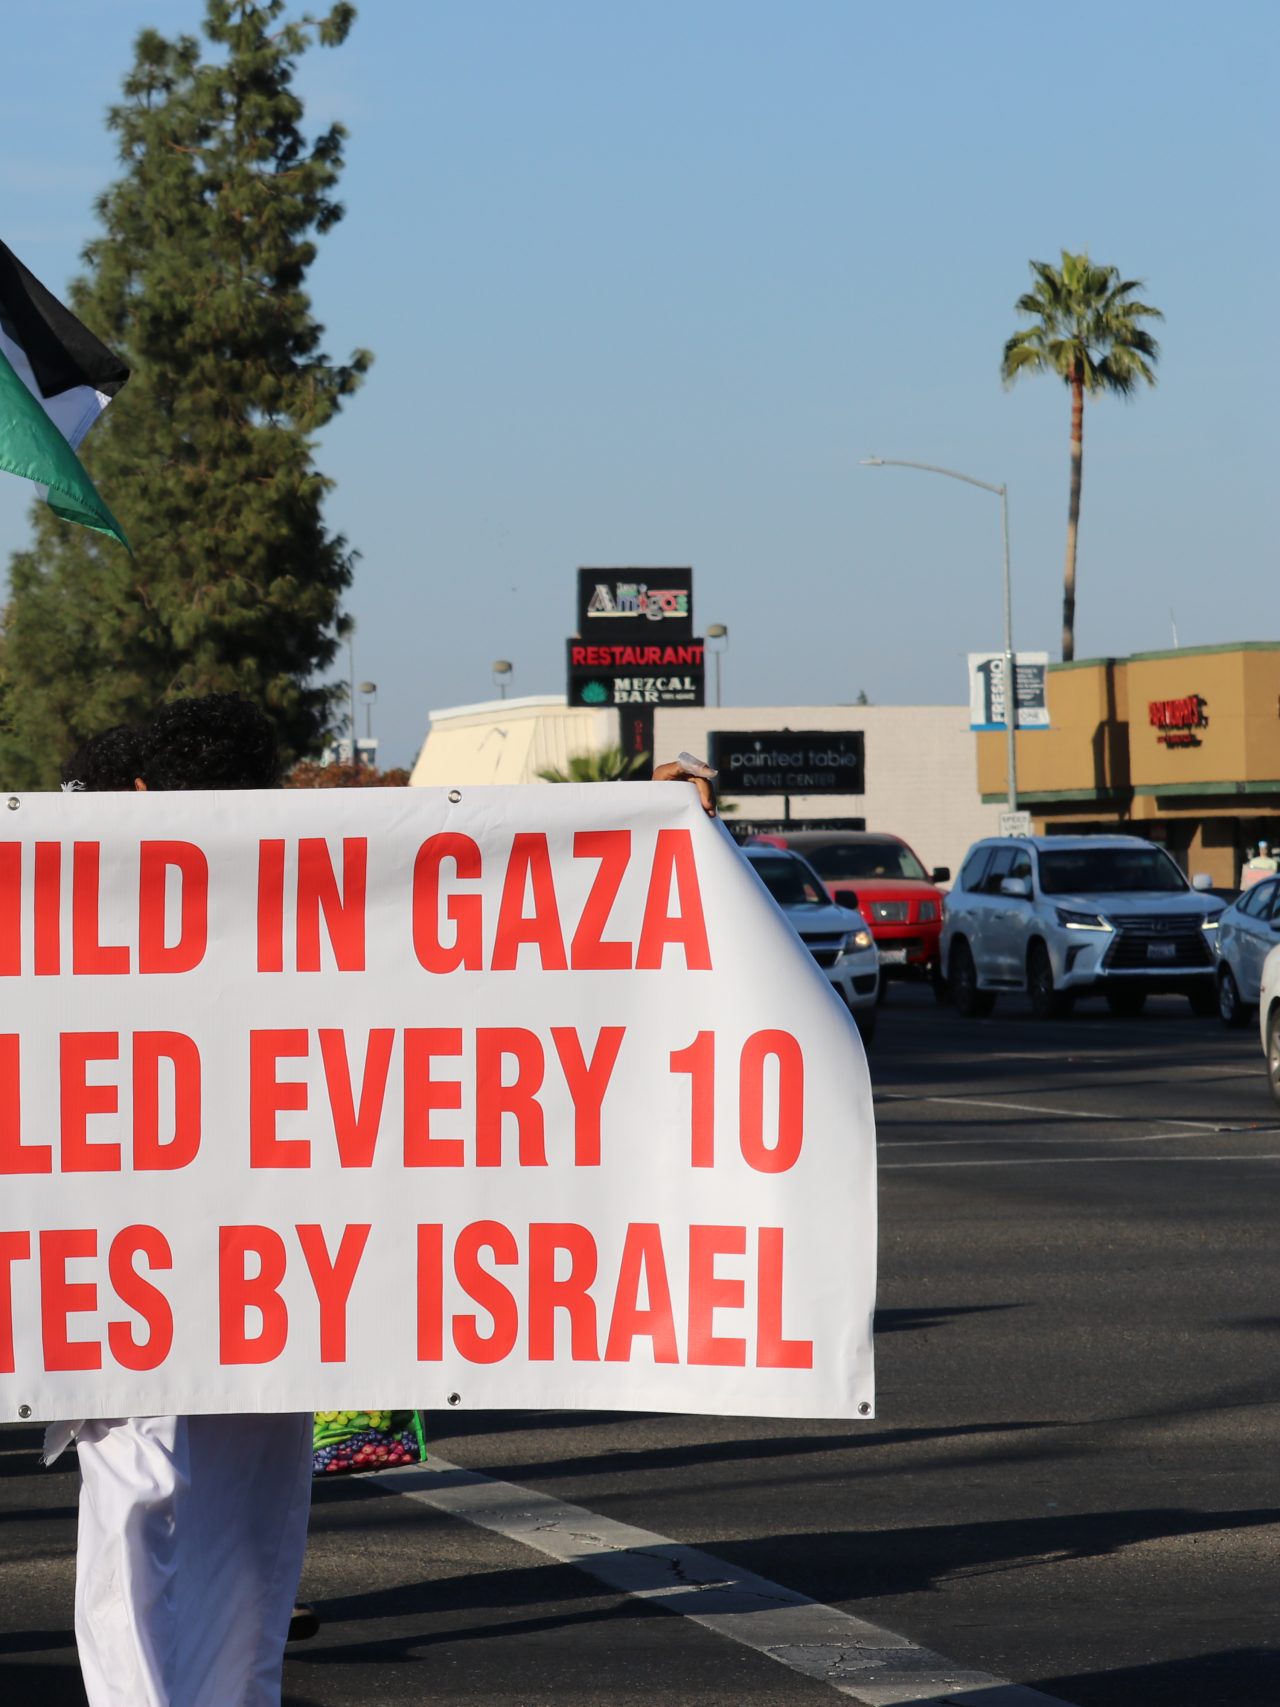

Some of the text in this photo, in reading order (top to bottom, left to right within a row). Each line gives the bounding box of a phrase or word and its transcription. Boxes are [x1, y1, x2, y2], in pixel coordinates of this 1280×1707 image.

[571, 645, 704, 666] RESTAURANT
[613, 676, 696, 691] MEZCAL
[613, 690, 659, 703] BAR
[990, 660, 1005, 722] FRESNO
[730, 741, 803, 769] painted
[743, 773, 836, 786] EVENT CENTER
[256, 836, 369, 974] IN
[411, 828, 713, 975] GAZA
[249, 1025, 627, 1169] EVERY
[669, 1028, 805, 1175] 10
[218, 1223, 373, 1366] BY
[416, 1219, 814, 1370] ISRAEL
